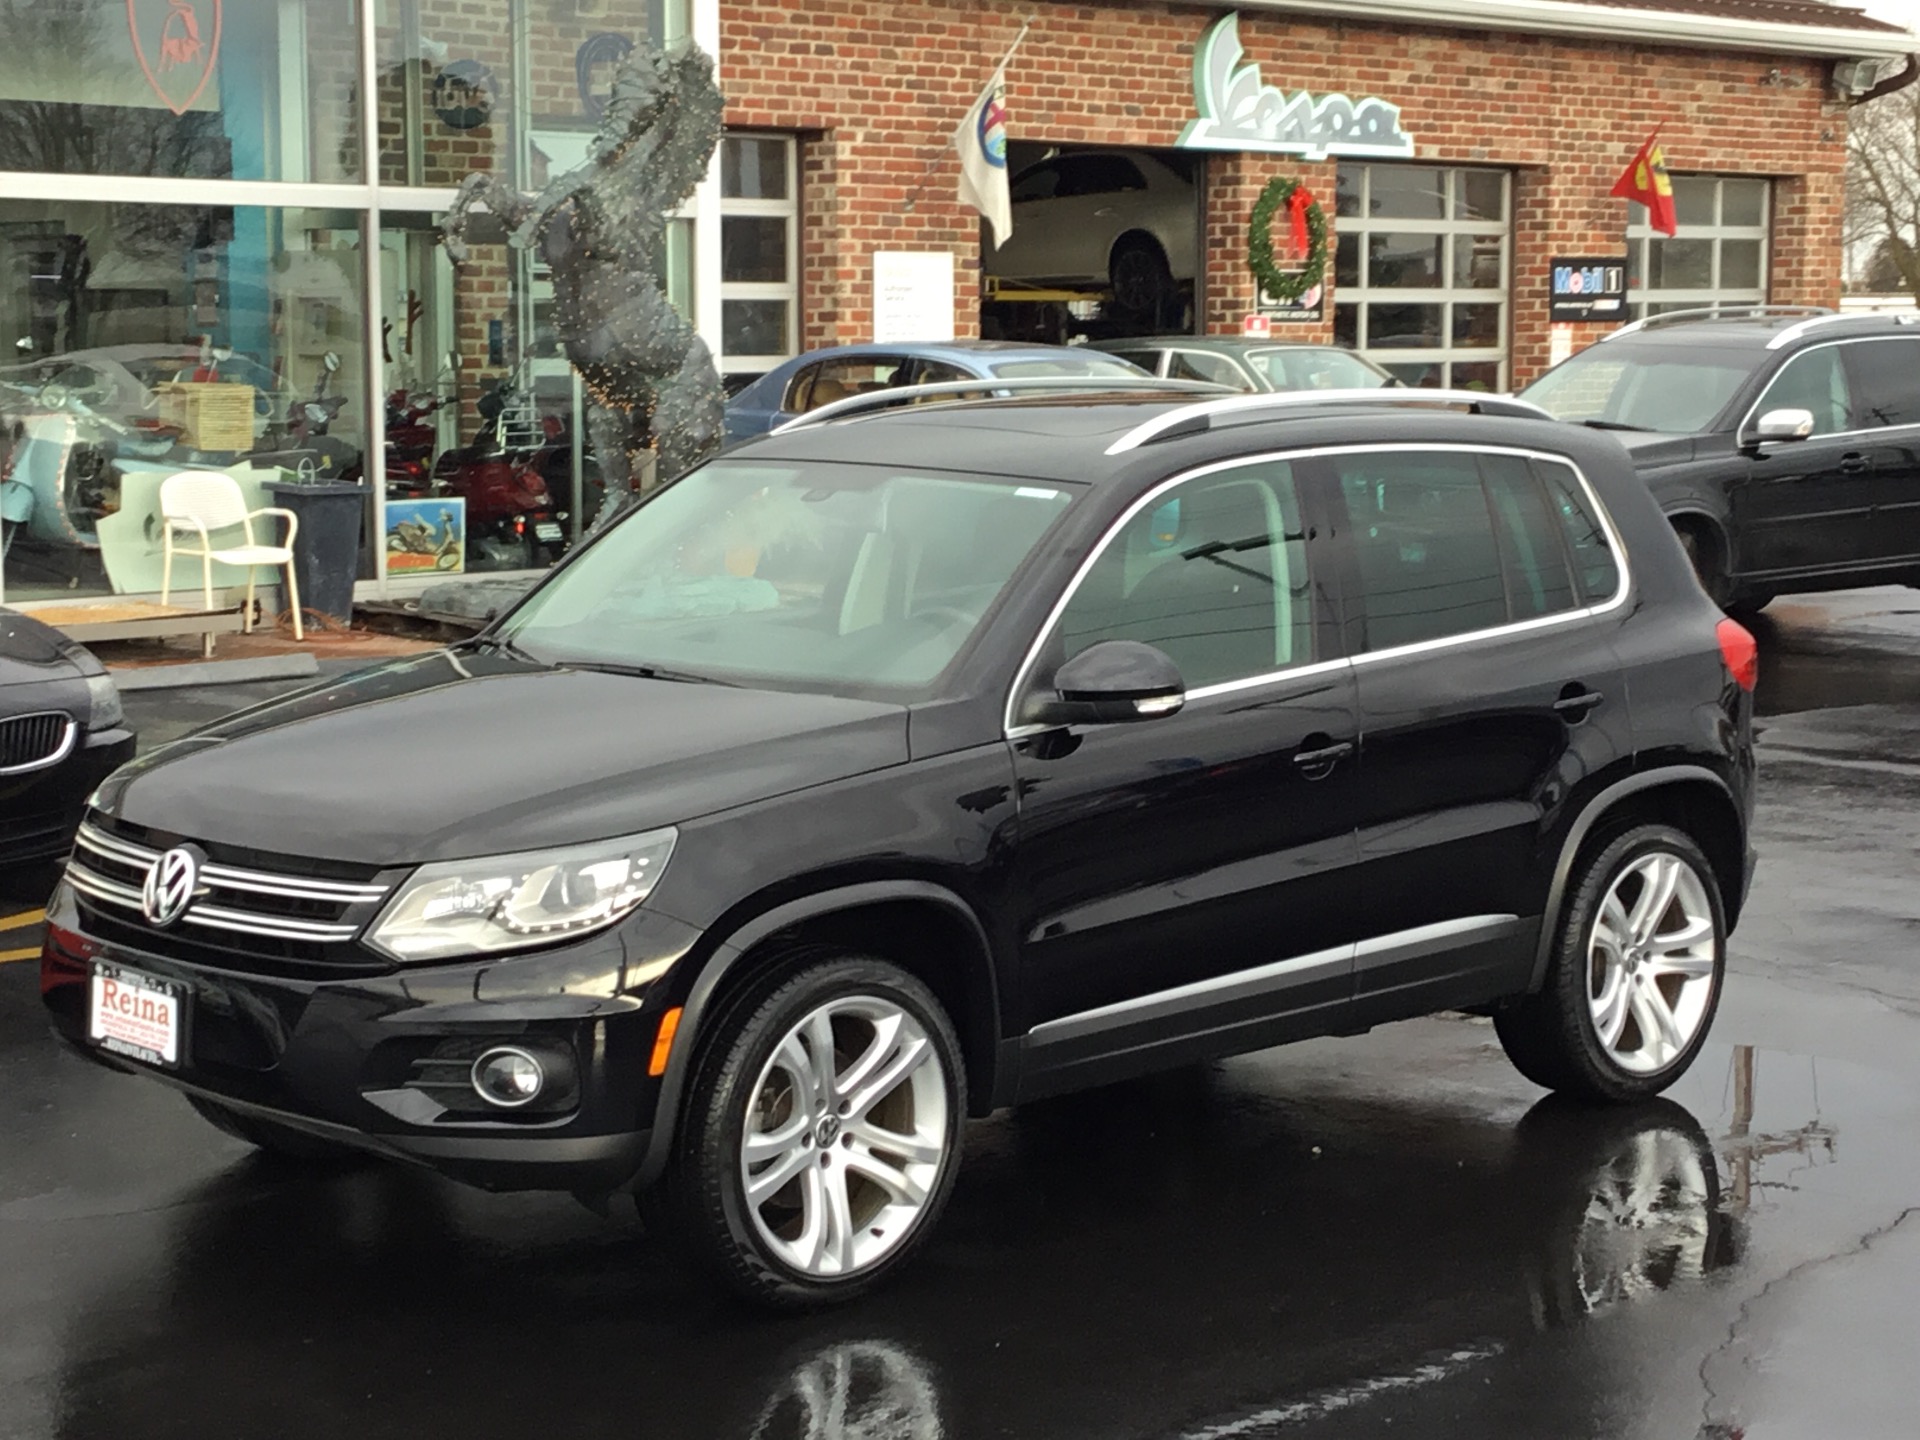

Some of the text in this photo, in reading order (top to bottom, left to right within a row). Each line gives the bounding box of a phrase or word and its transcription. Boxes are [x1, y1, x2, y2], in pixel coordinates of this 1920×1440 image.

[1202, 12, 1411, 155] Vespa
[1555, 266, 1622, 294] Mobil 1
[101, 977, 171, 1027] Reina
